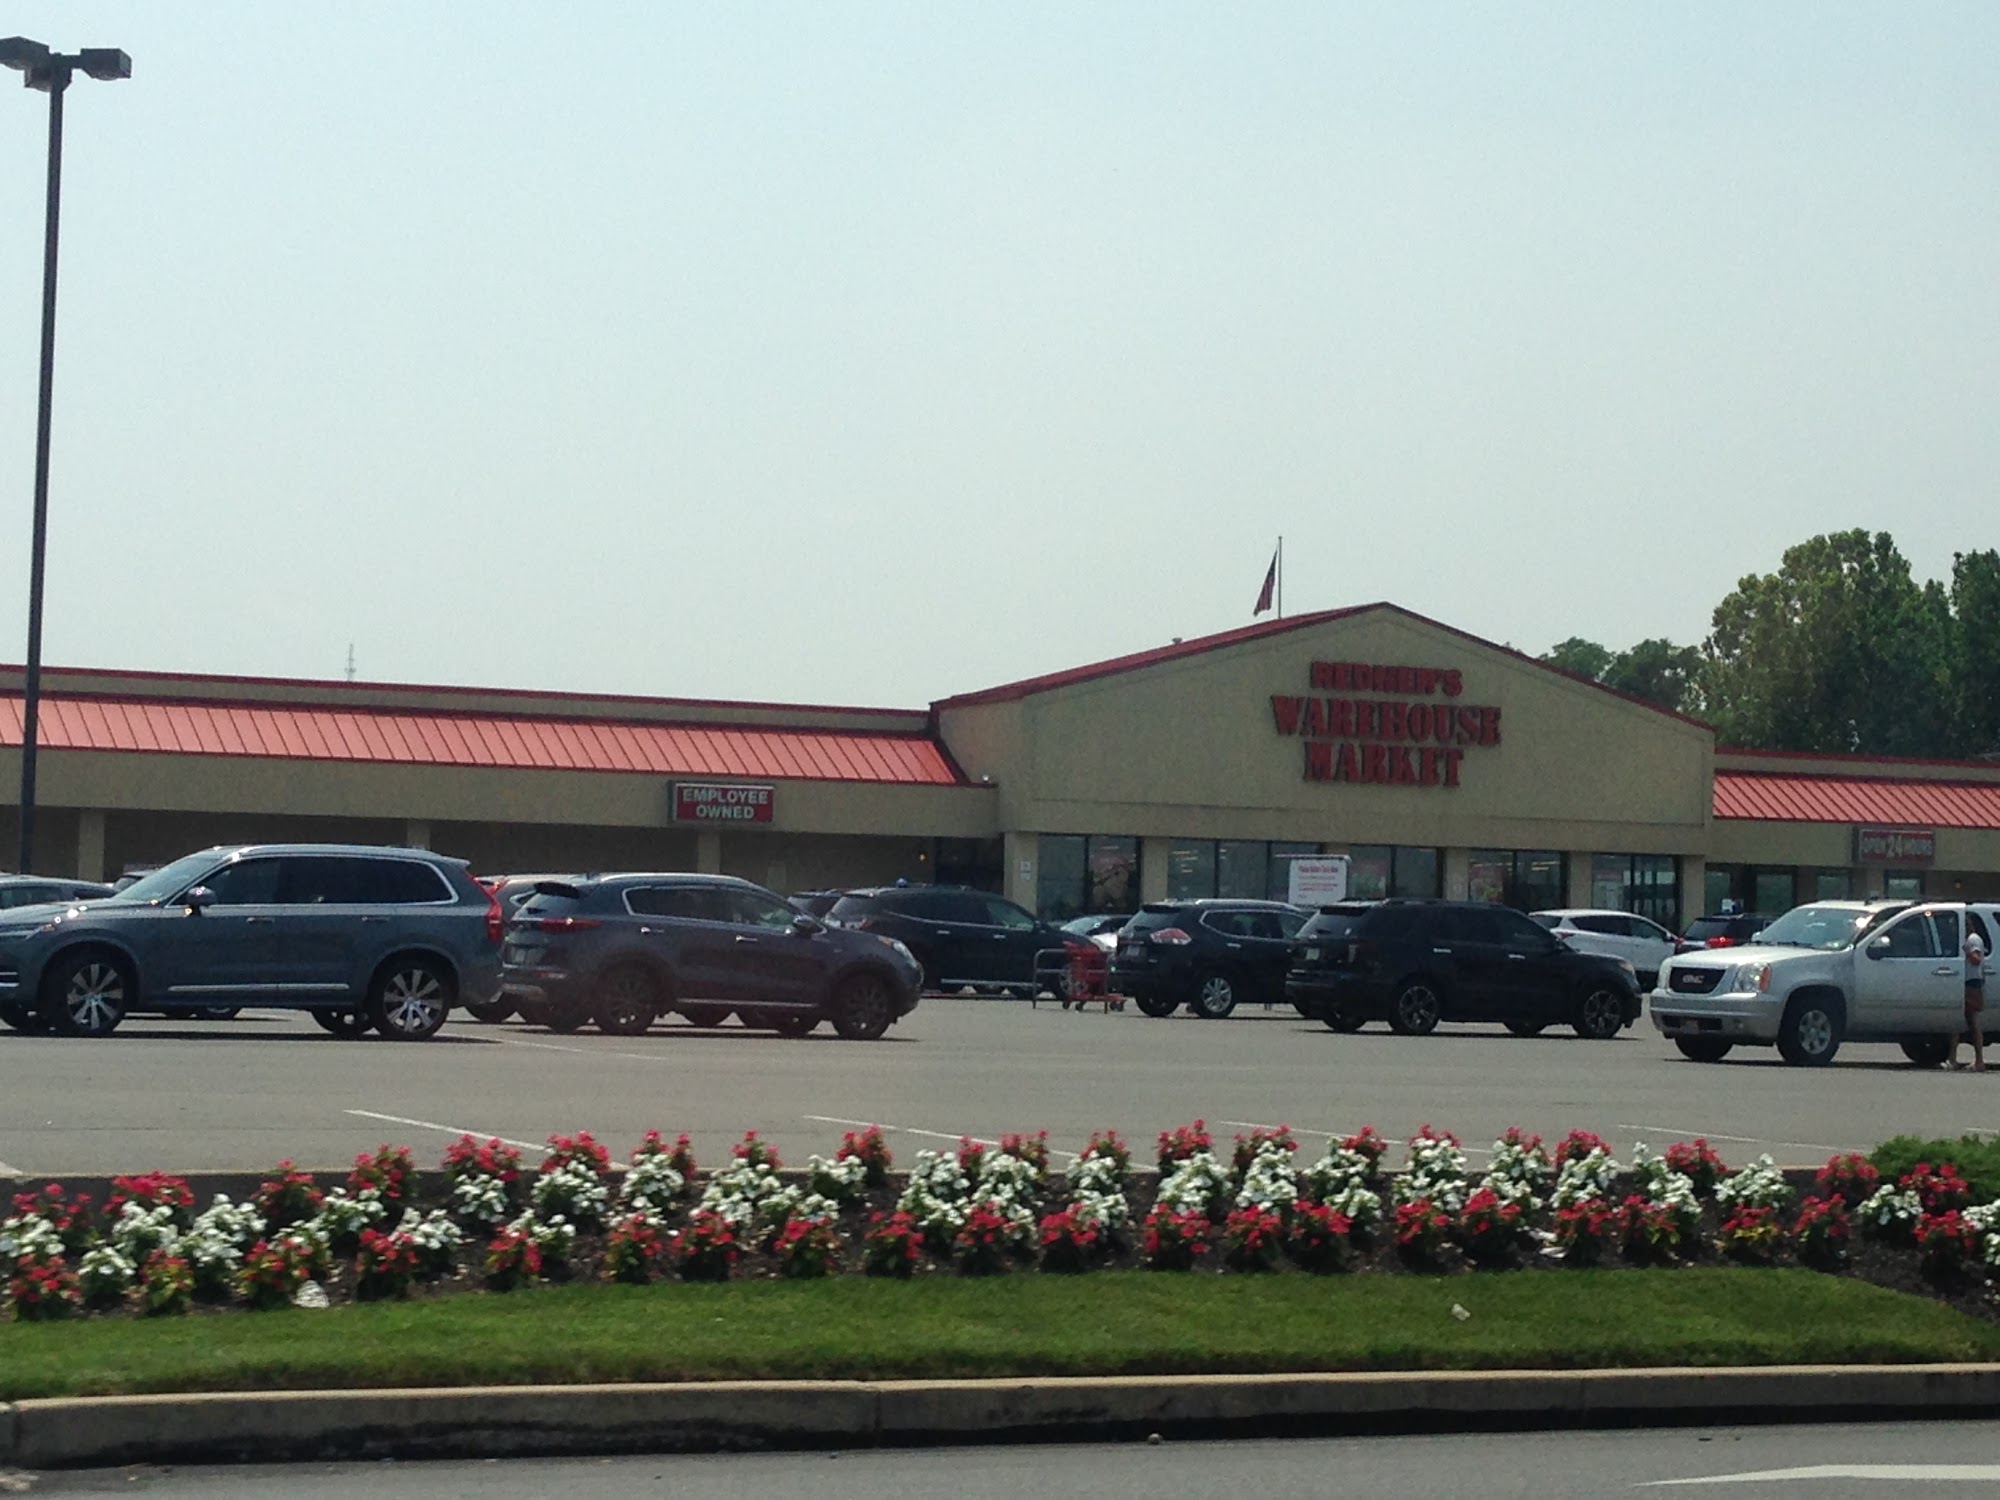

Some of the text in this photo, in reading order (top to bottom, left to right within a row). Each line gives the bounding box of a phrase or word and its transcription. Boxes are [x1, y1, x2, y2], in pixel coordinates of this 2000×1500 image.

[1270, 695, 1501, 746] WAREHOUSE
[1303, 741, 1464, 788] MARKET
[683, 788, 768, 804] EMPLOYEE
[696, 804, 754, 819] OWNED
